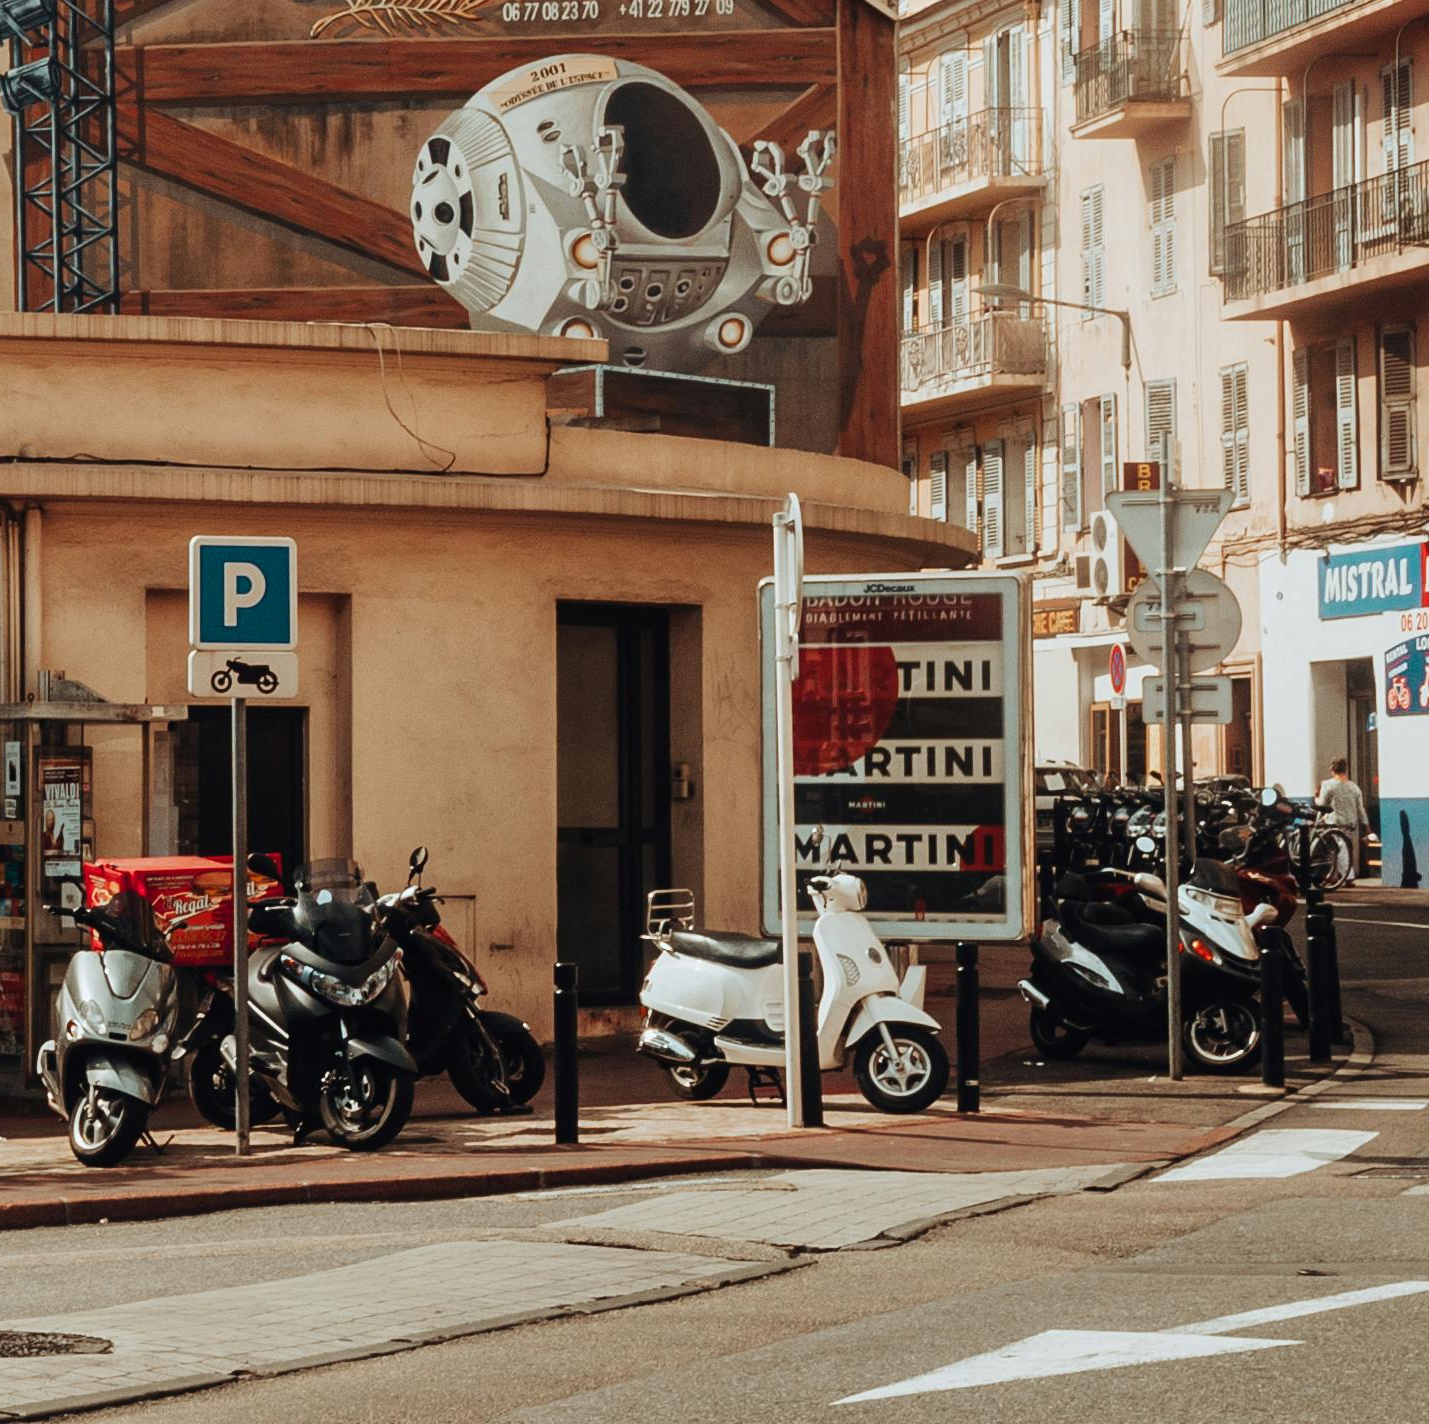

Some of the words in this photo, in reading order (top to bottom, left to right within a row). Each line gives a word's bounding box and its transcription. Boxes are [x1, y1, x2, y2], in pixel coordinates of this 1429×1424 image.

[502, 2, 520, 22] 06
[523, 2, 539, 21] 77
[542, 2, 559, 21] 08
[561, 1, 578, 20] 23
[581, 0, 599, 19] 70
[530, 62, 567, 82] 2001
[863, 584, 915, 593] JCDecaux
[1324, 558, 1413, 604] MISTRAL
[224, 562, 267, 627] P
[1401, 614, 1413, 632] 06
[1416, 613, 1428, 631] 20
[896, 660, 991, 692] TINI
[45, 782, 80, 801] VIVALDI
[848, 801, 886, 809] MARTINI
[795, 833, 992, 865] MARTINI
